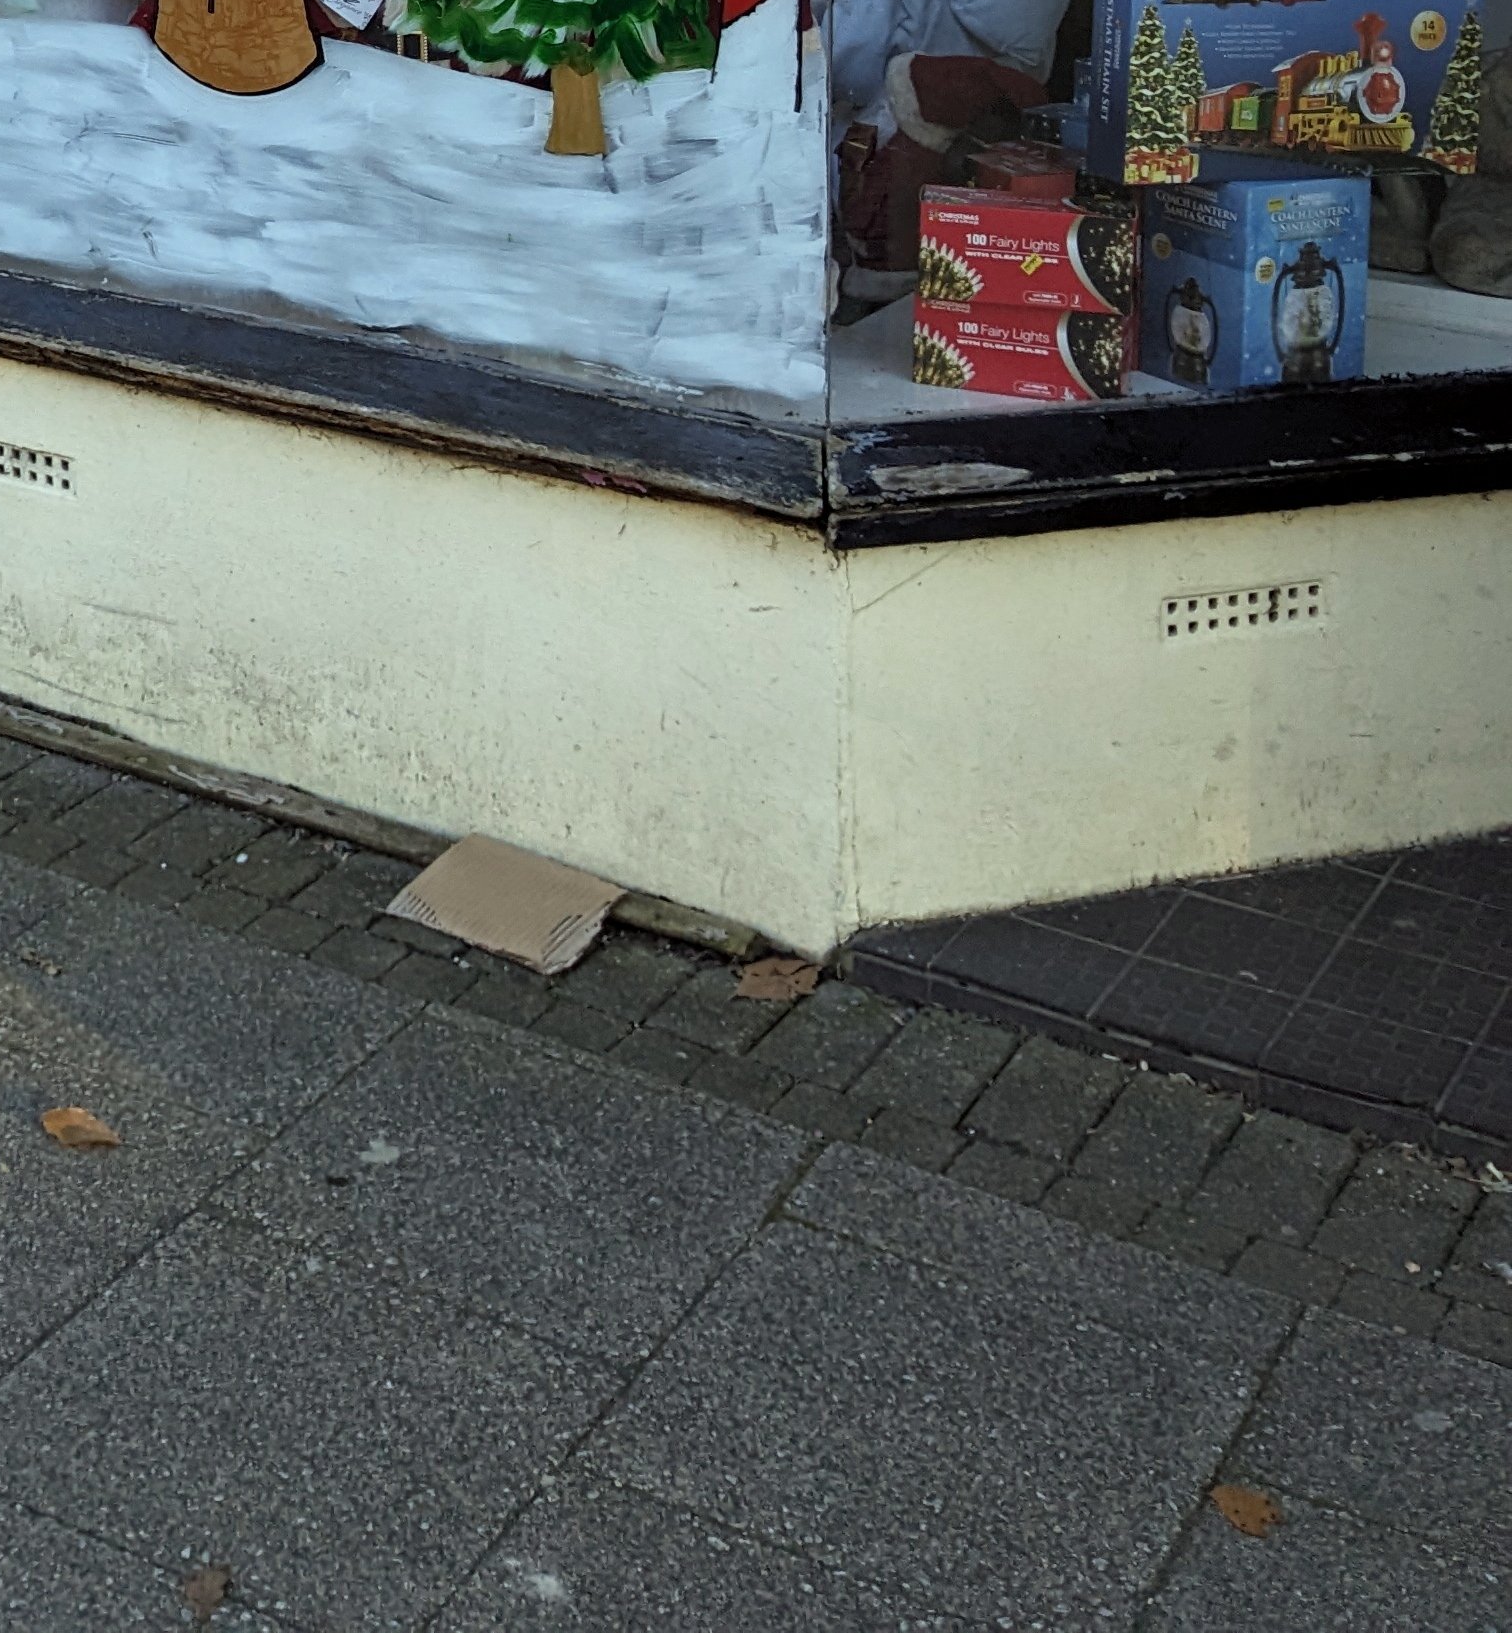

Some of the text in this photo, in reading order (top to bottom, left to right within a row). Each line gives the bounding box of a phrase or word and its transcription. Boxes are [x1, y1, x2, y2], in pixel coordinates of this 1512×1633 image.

[1422, 20, 1435, 31] 14
[1102, 49, 1112, 95] TRAIN
[1100, 96, 1109, 123] SET
[938, 211, 979, 221] CHRISTMAS
[1195, 200, 1238, 223] LANTERN
[1302, 206, 1351, 218] LANTERN
[1197, 213, 1228, 230] SCENE
[966, 233, 1060, 252] 100 Fairy Lights
[991, 253, 1023, 261] CLEAR
[958, 321, 1050, 344] 100 Fairy Lights
[982, 341, 1013, 351] CLEAR
[1015, 345, 1049, 355] BULBS
